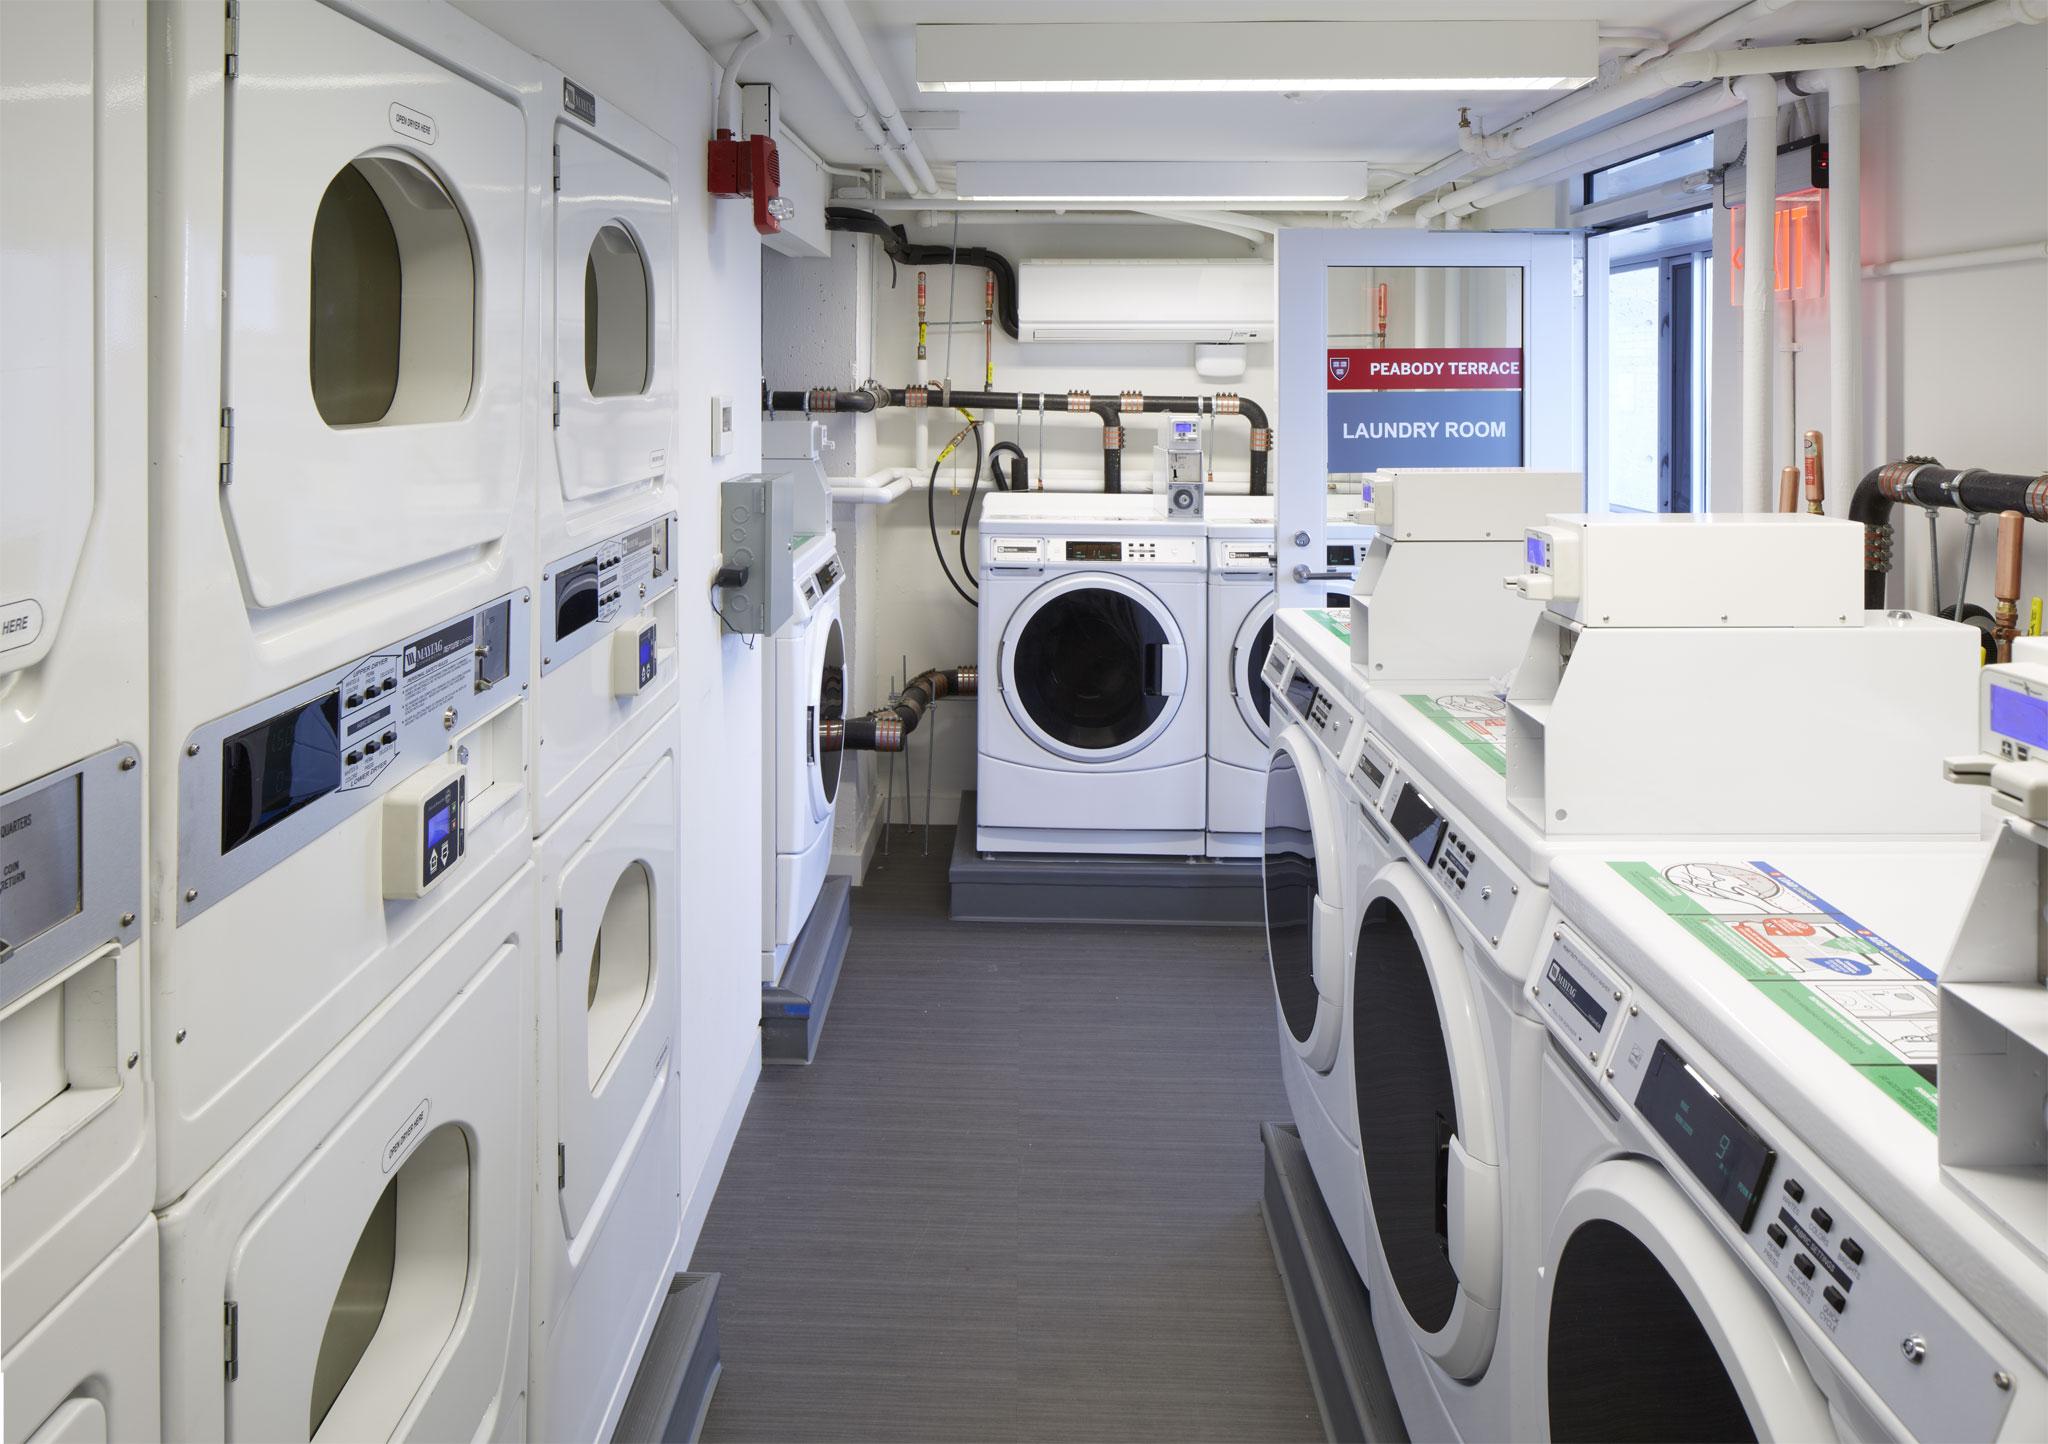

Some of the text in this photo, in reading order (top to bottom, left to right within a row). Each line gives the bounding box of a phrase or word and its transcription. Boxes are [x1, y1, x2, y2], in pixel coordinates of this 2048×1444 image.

[396, 114, 431, 135] OPEN DRYER HERE
[1370, 361, 1520, 376] PEABODY TERRACE
[1343, 420, 1506, 439] LAUNDRY ROOM
[2, 615, 29, 635] HERE
[417, 639, 442, 662] MAYTAG
[353, 657, 387, 678] UPPER DRYER
[350, 759, 386, 787] LOWER DRYER
[1, 814, 32, 838] QUARTERS
[4, 860, 20, 876] COIN
[0, 871, 26, 891] RETURN
[1555, 973, 1576, 998] MAYTAG
[389, 1141, 400, 1158] OPEN
[414, 1110, 424, 1128] HERE
[1716, 1134, 1730, 1160] 9
[1808, 1222, 1828, 1247] COLORS
[1763, 1248, 1778, 1268] PRESS
[1793, 1224, 1835, 1272] FABRIC SETTINGS
[1837, 1252, 1860, 1280] BRIGHTS
[1788, 1265, 1814, 1298] DELICATES
[1796, 1285, 1810, 1304] KNITS
[1819, 1311, 1835, 1333] CYCLE
[1822, 1304, 1839, 1325] QUICK
